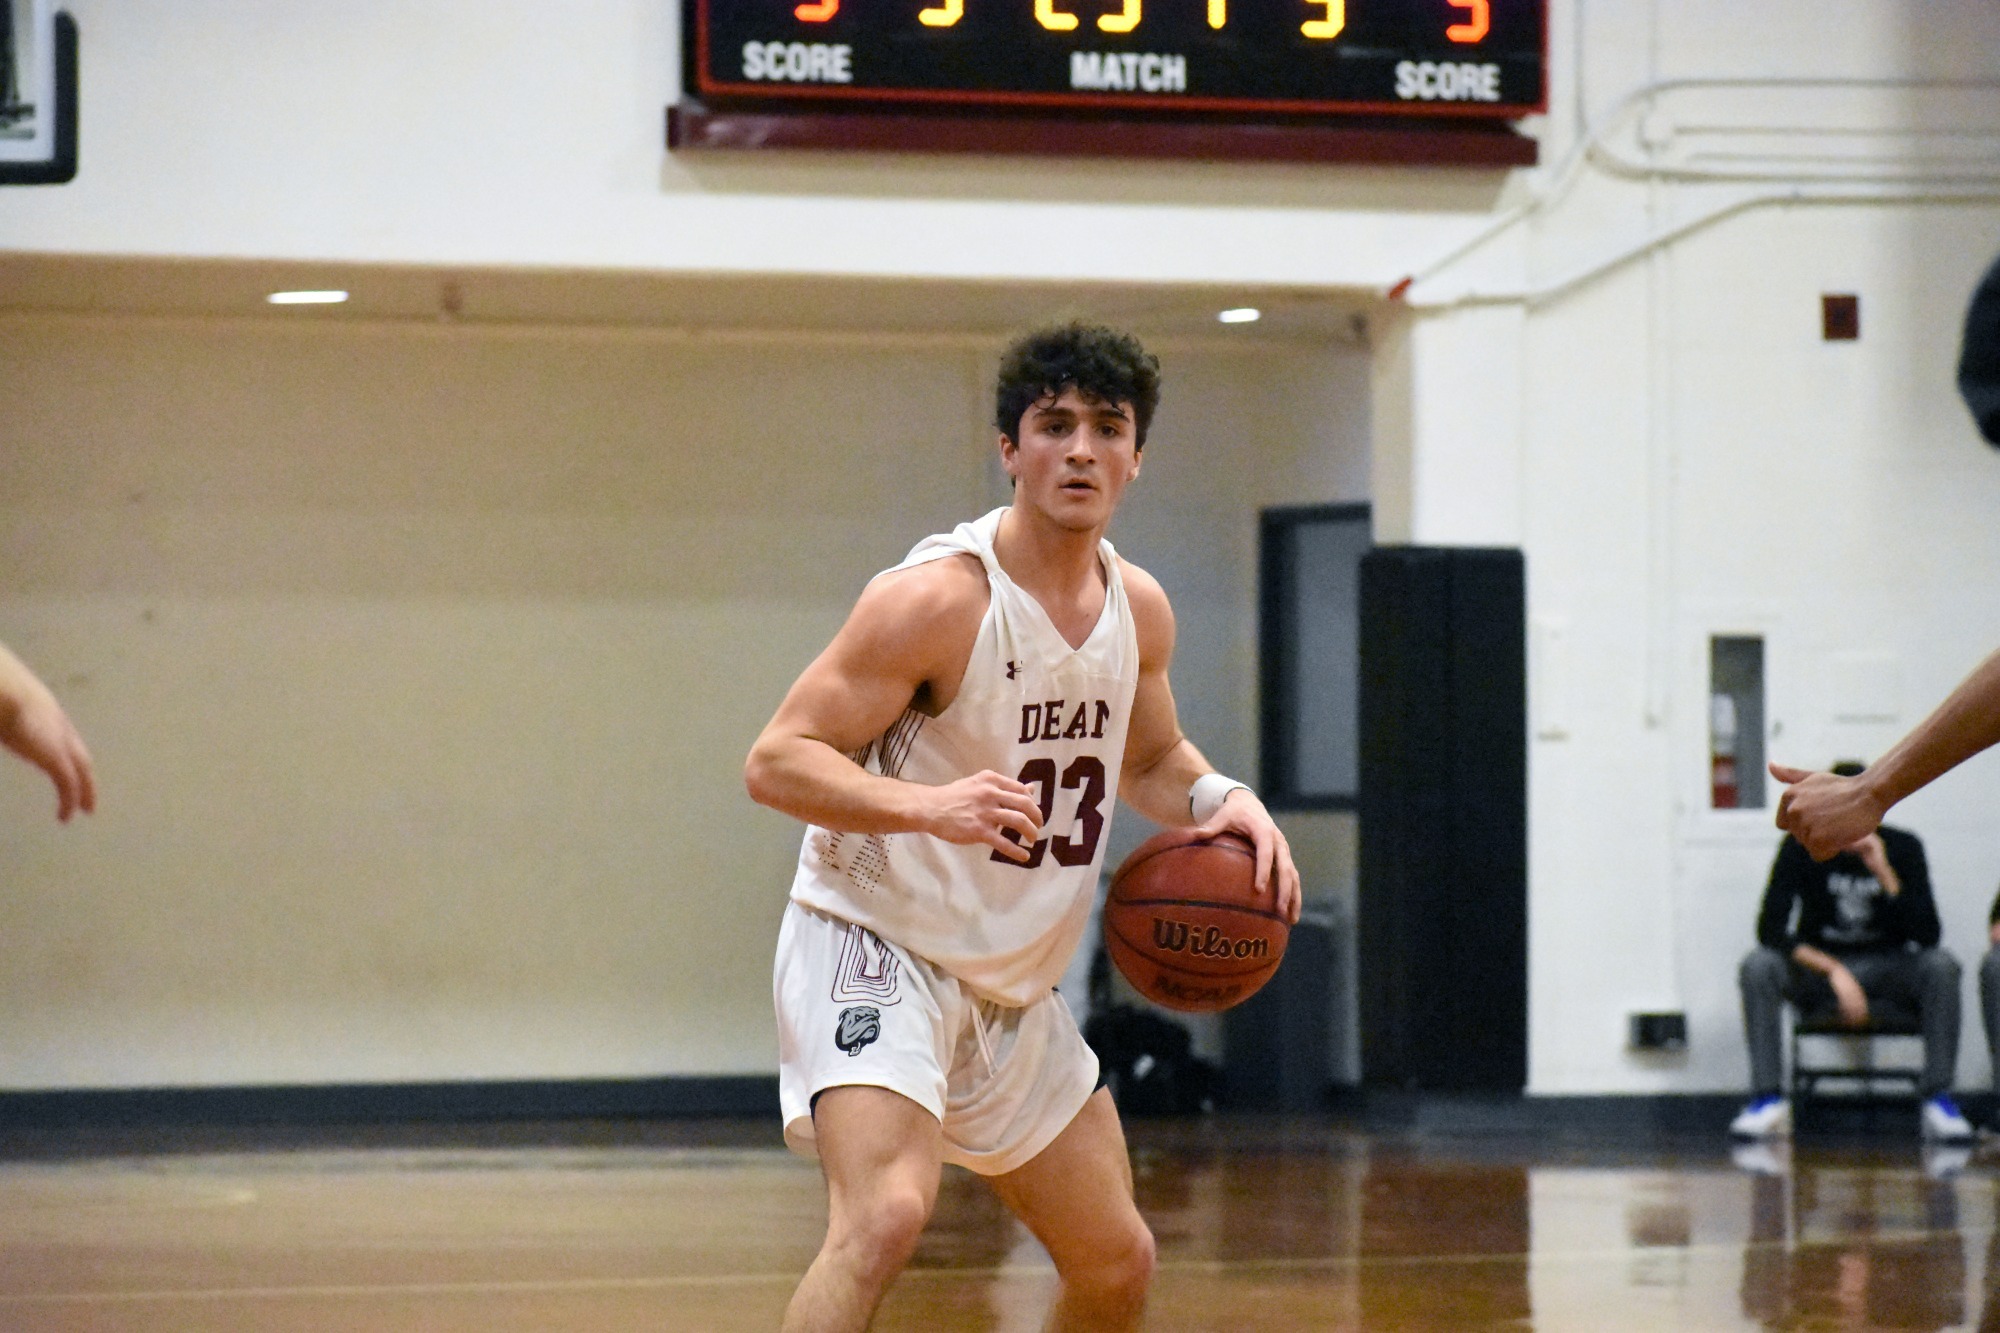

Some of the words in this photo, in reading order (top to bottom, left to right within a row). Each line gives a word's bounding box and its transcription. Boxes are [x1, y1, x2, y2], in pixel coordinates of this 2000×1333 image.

[743, 41, 852, 82] SCORE
[1070, 51, 1186, 91] MATCH
[1395, 61, 1500, 99] SCORE
[1153, 917, 1269, 959] Wilson
